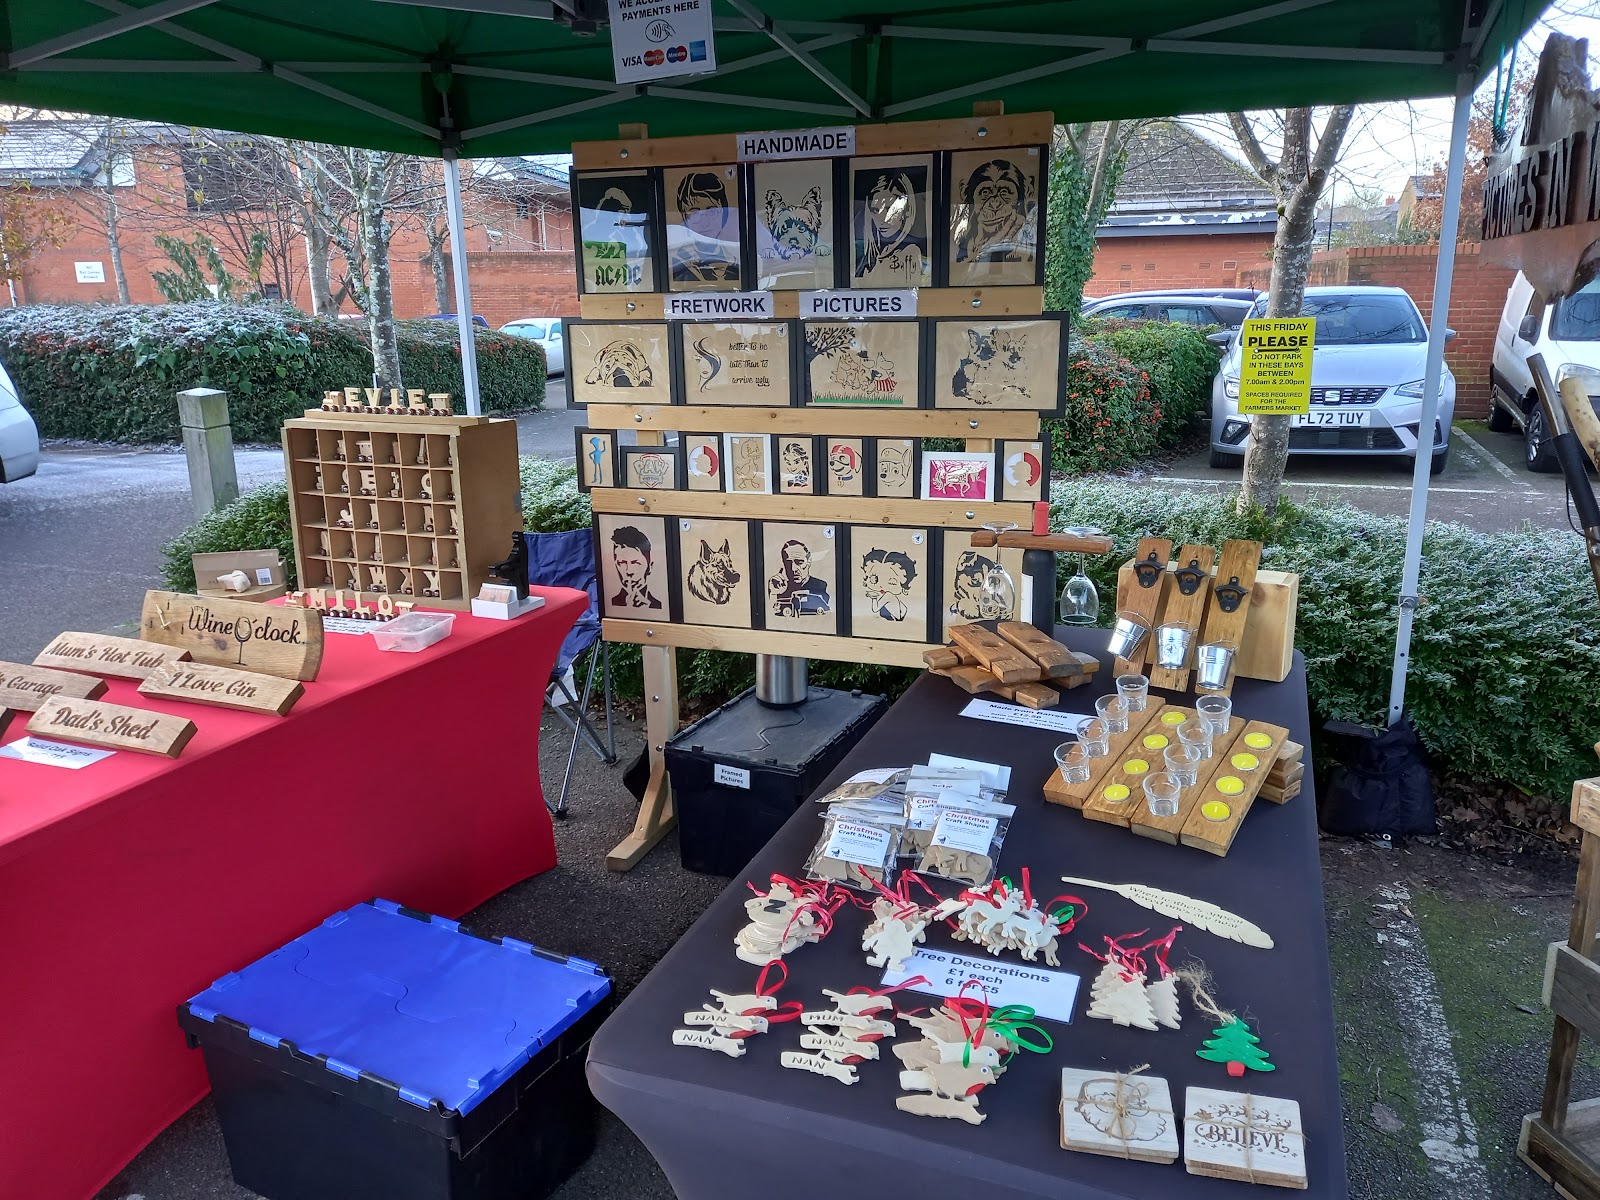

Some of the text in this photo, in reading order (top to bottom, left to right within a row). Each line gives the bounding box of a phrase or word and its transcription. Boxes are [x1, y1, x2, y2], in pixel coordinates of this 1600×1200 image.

[618, 0, 633, 9] WE
[622, 0, 700, 21] PAYMENTS HERE
[622, 56, 642, 67] VISA
[744, 132, 847, 155] HANDMADE
[1482, 151, 1540, 240] PICTURES
[890, 254, 917, 284] Buffy
[671, 297, 766, 314] FRETWORK
[813, 296, 902, 313] PICTURES
[1273, 323, 1308, 331] FRIDAY
[1248, 336, 1309, 347] PLEASE
[1299, 413, 1364, 424] FL72 TUY
[188, 606, 233, 635] Wine
[45, 641, 165, 669] Mum's Hot Tub
[6, 675, 63, 699] Garage
[179, 672, 225, 693] Love
[225, 679, 257, 698] Gin
[50, 706, 160, 740] Dad's Shed
[720, 775, 744, 784] Pictures
[721, 769, 743, 778] Framed
[945, 812, 990, 825] Christmas
[964, 820, 990, 830] Shapes
[838, 823, 883, 838] Christmas
[838, 829, 883, 843] Craft Shapes
[914, 950, 1050, 983] Tree Decorations
[945, 977, 953, 985] 6
[948, 968, 1003, 985] £1 each
[694, 1013, 727, 1022] NAN
[809, 1013, 844, 1022] MUM
[682, 1033, 715, 1045] NAN
[812, 1037, 844, 1047] NAN
[792, 1055, 825, 1069] NAN
[1195, 1122, 1289, 1153] BELIEVE
